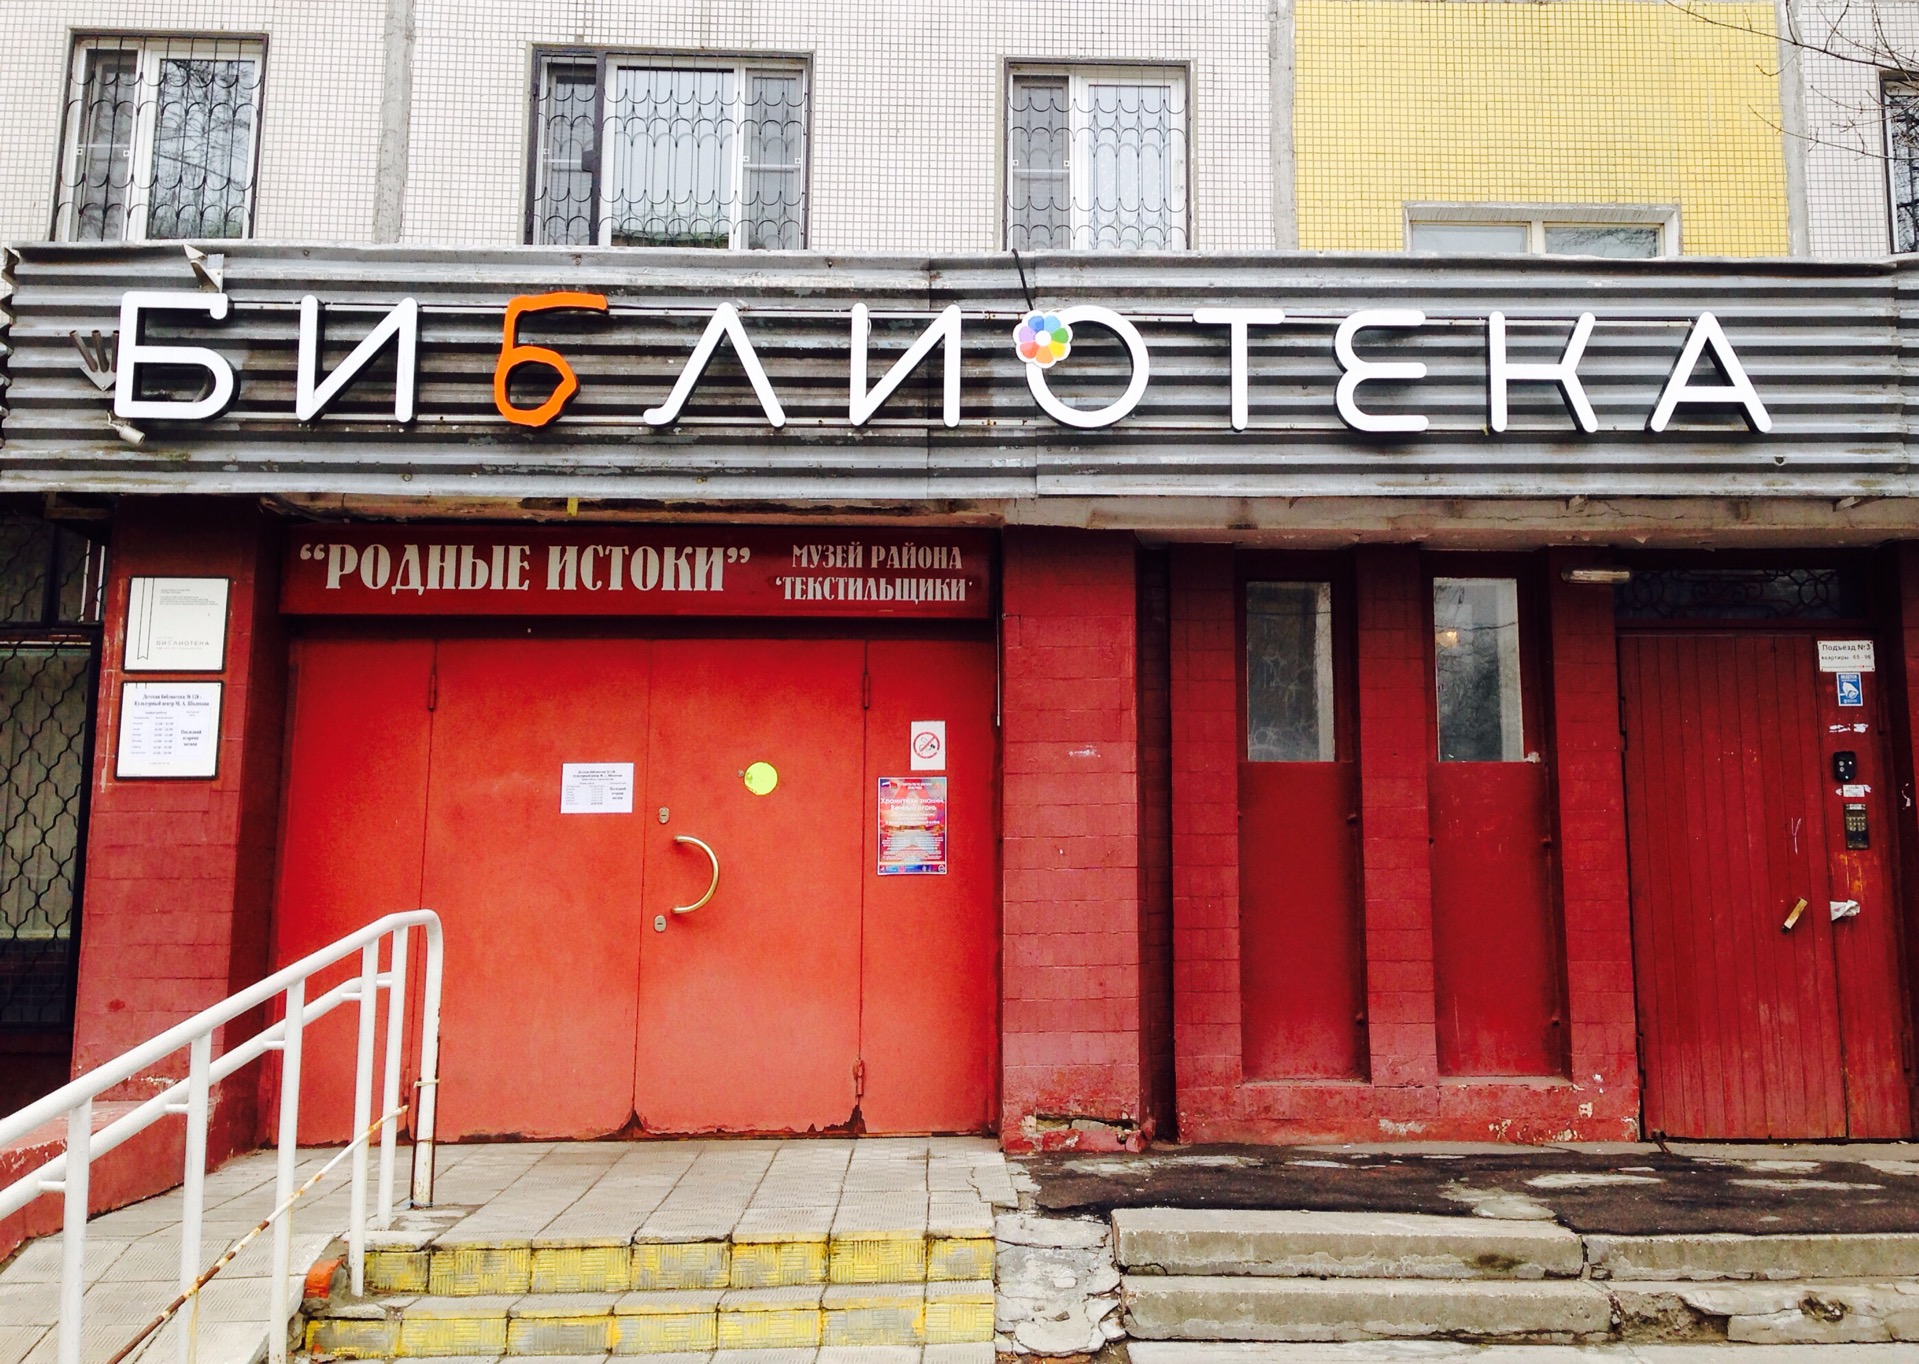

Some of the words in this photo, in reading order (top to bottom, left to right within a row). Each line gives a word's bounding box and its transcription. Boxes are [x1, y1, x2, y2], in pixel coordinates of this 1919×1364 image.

[791, 541, 864, 569] МУЗЕЙ
[870, 542, 964, 569] РАЙОНА
[300, 543, 531, 596] “РОДНЫЕ
[545, 544, 751, 592] ИСТОКИ”
[1822, 644, 1857, 652] Подъезд
